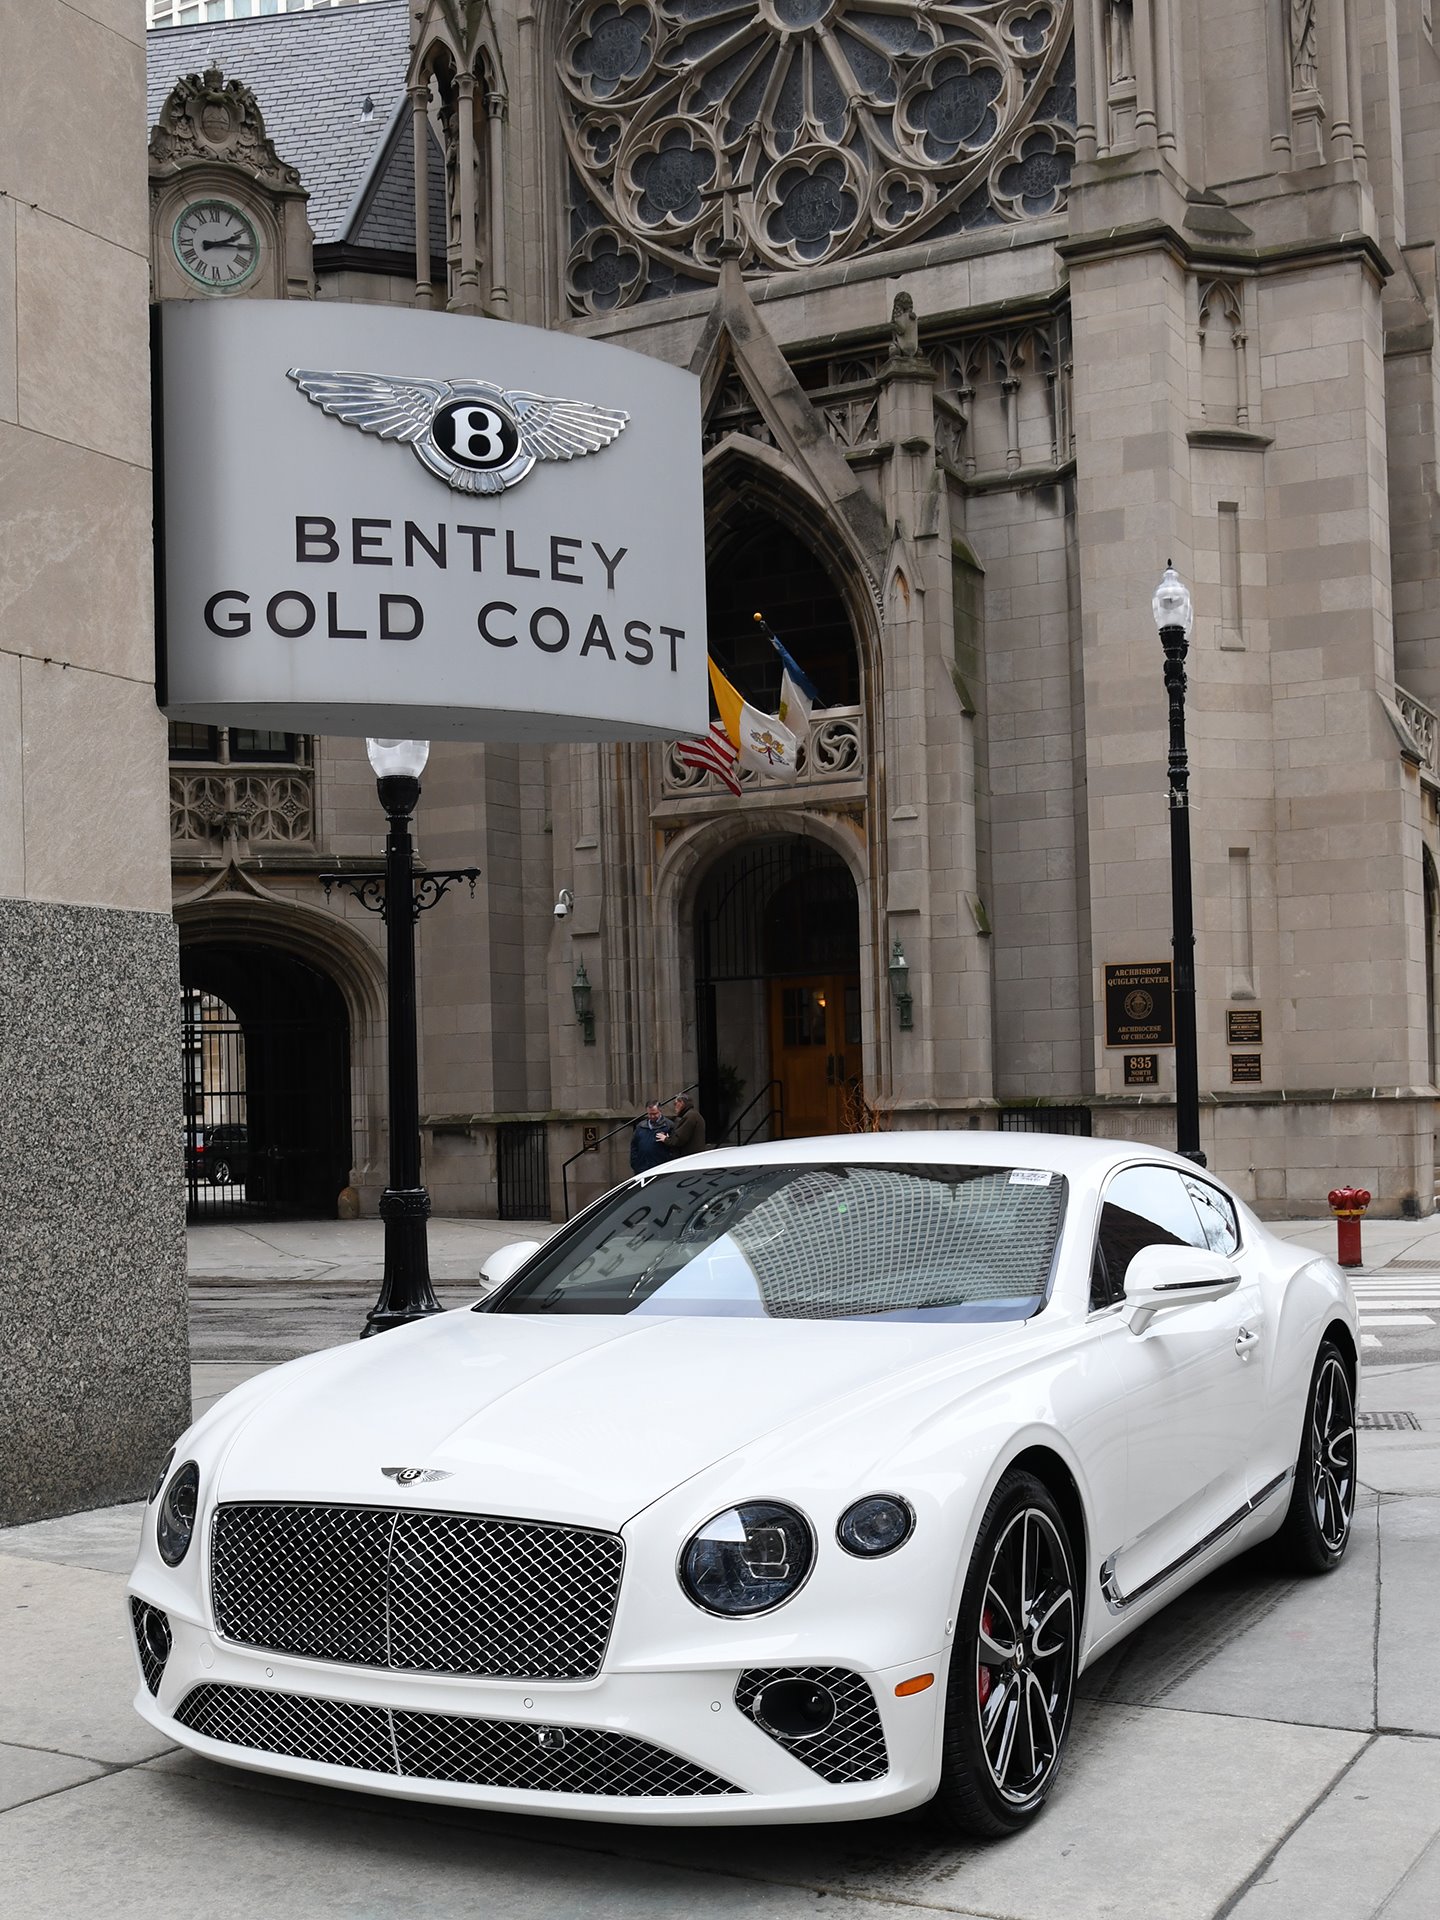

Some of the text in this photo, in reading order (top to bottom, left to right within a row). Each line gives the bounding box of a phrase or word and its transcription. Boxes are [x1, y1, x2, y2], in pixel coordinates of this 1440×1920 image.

[451, 406, 504, 462] B
[294, 514, 629, 591] BENTLEY
[203, 589, 687, 673] GOLD COAST
[1115, 967, 1162, 977] ARCHBISHOP
[1107, 976, 1169, 987] QUIGLEY CENTER
[1117, 1025, 1162, 1034] ARCHDIOCESE
[1129, 1033, 1159, 1041] CHICAGO
[1130, 1056, 1152, 1070] 835
